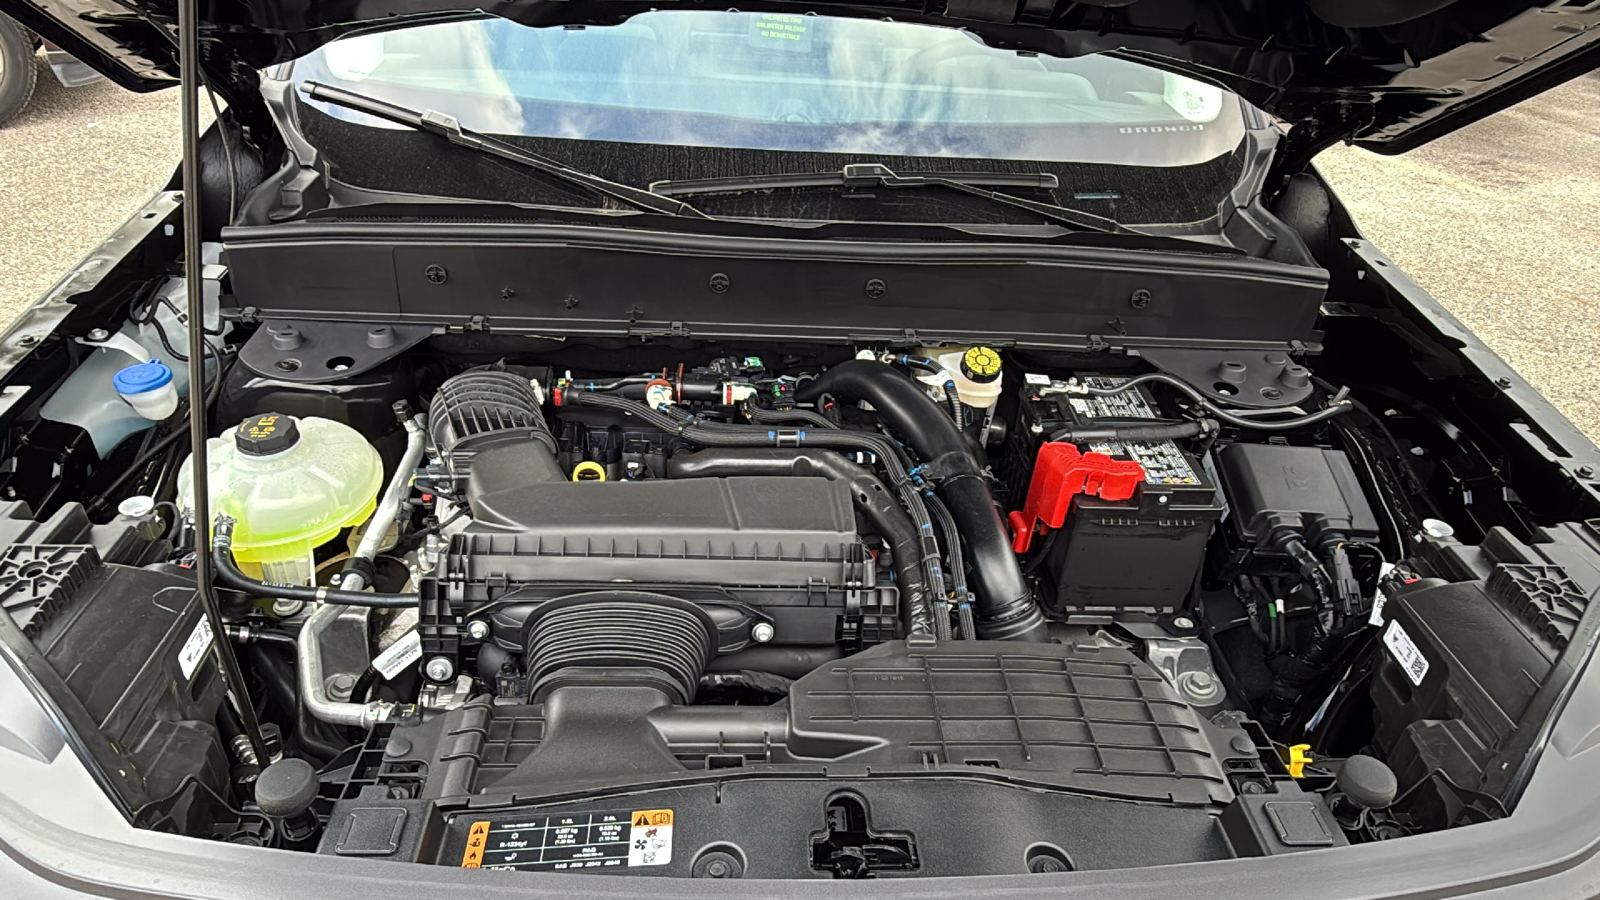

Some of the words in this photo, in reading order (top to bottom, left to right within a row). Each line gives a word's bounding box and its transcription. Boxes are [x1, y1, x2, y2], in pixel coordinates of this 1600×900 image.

[757, 22, 784, 30] UNLIMITED
[784, 25, 806, 33] MILEAGE
[770, 32, 800, 40] DEDUCTIBLE
